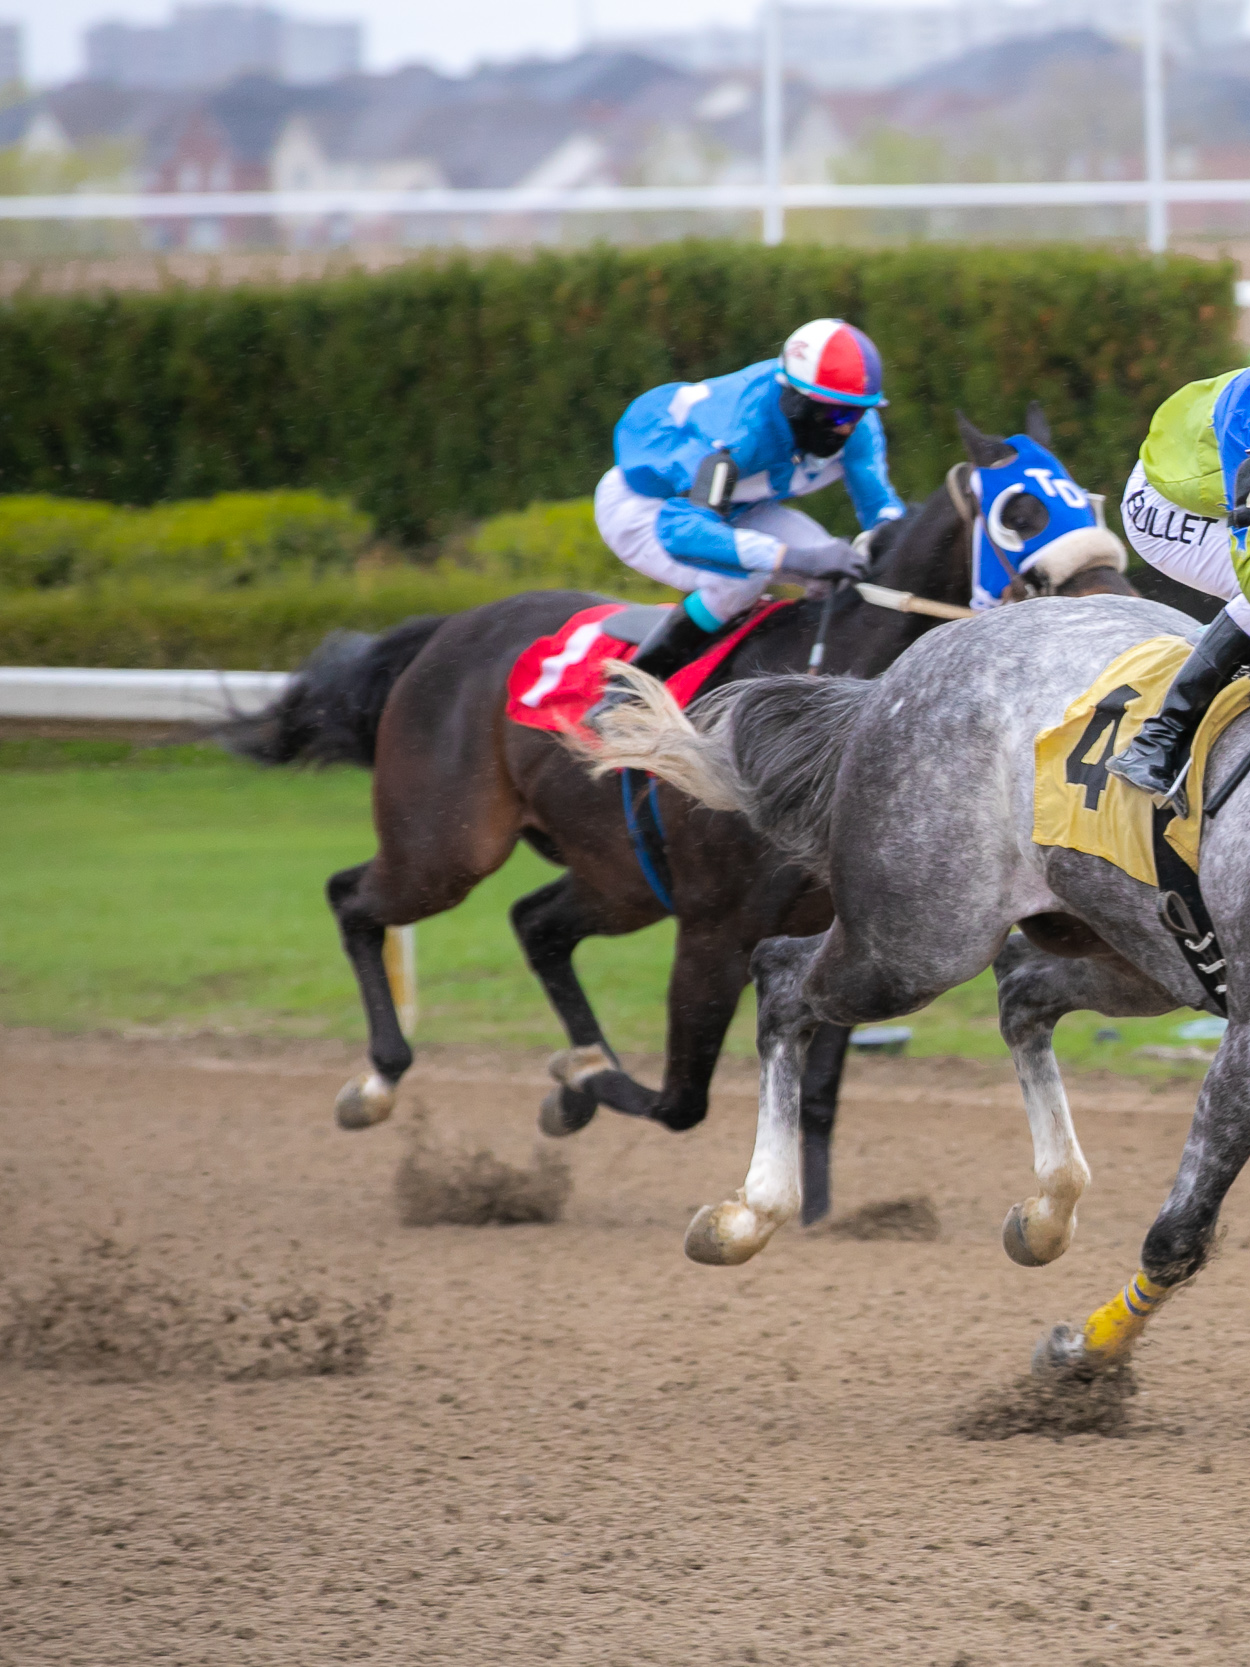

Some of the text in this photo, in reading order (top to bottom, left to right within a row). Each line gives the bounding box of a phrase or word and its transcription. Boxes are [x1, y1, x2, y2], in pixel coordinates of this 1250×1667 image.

[1127, 490, 1219, 546] BULLET
[520, 621, 603, 708] 1
[1065, 683, 1143, 811] 4
